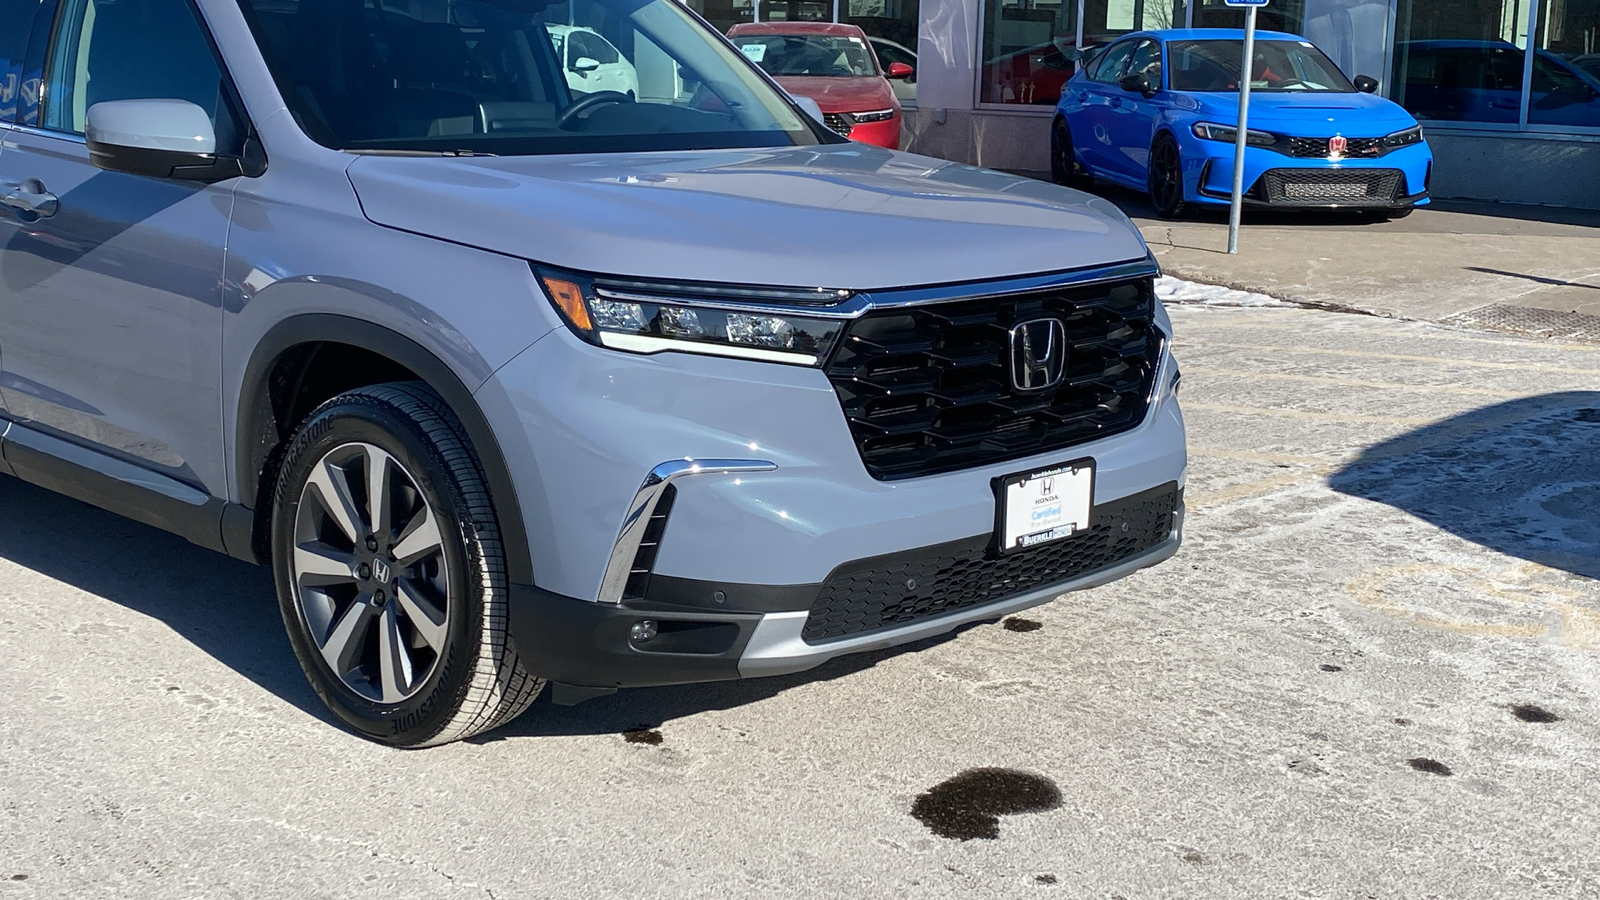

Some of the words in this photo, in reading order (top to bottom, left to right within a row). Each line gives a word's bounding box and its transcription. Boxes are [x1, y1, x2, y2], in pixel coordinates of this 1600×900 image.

[276, 414, 334, 509] BRIDGESTONE
[1035, 495, 1059, 505] HONDA
[1031, 504, 1061, 520] Certified
[1031, 516, 1061, 527] Pre-Owned
[391, 641, 454, 735] BRIDGESTONE
